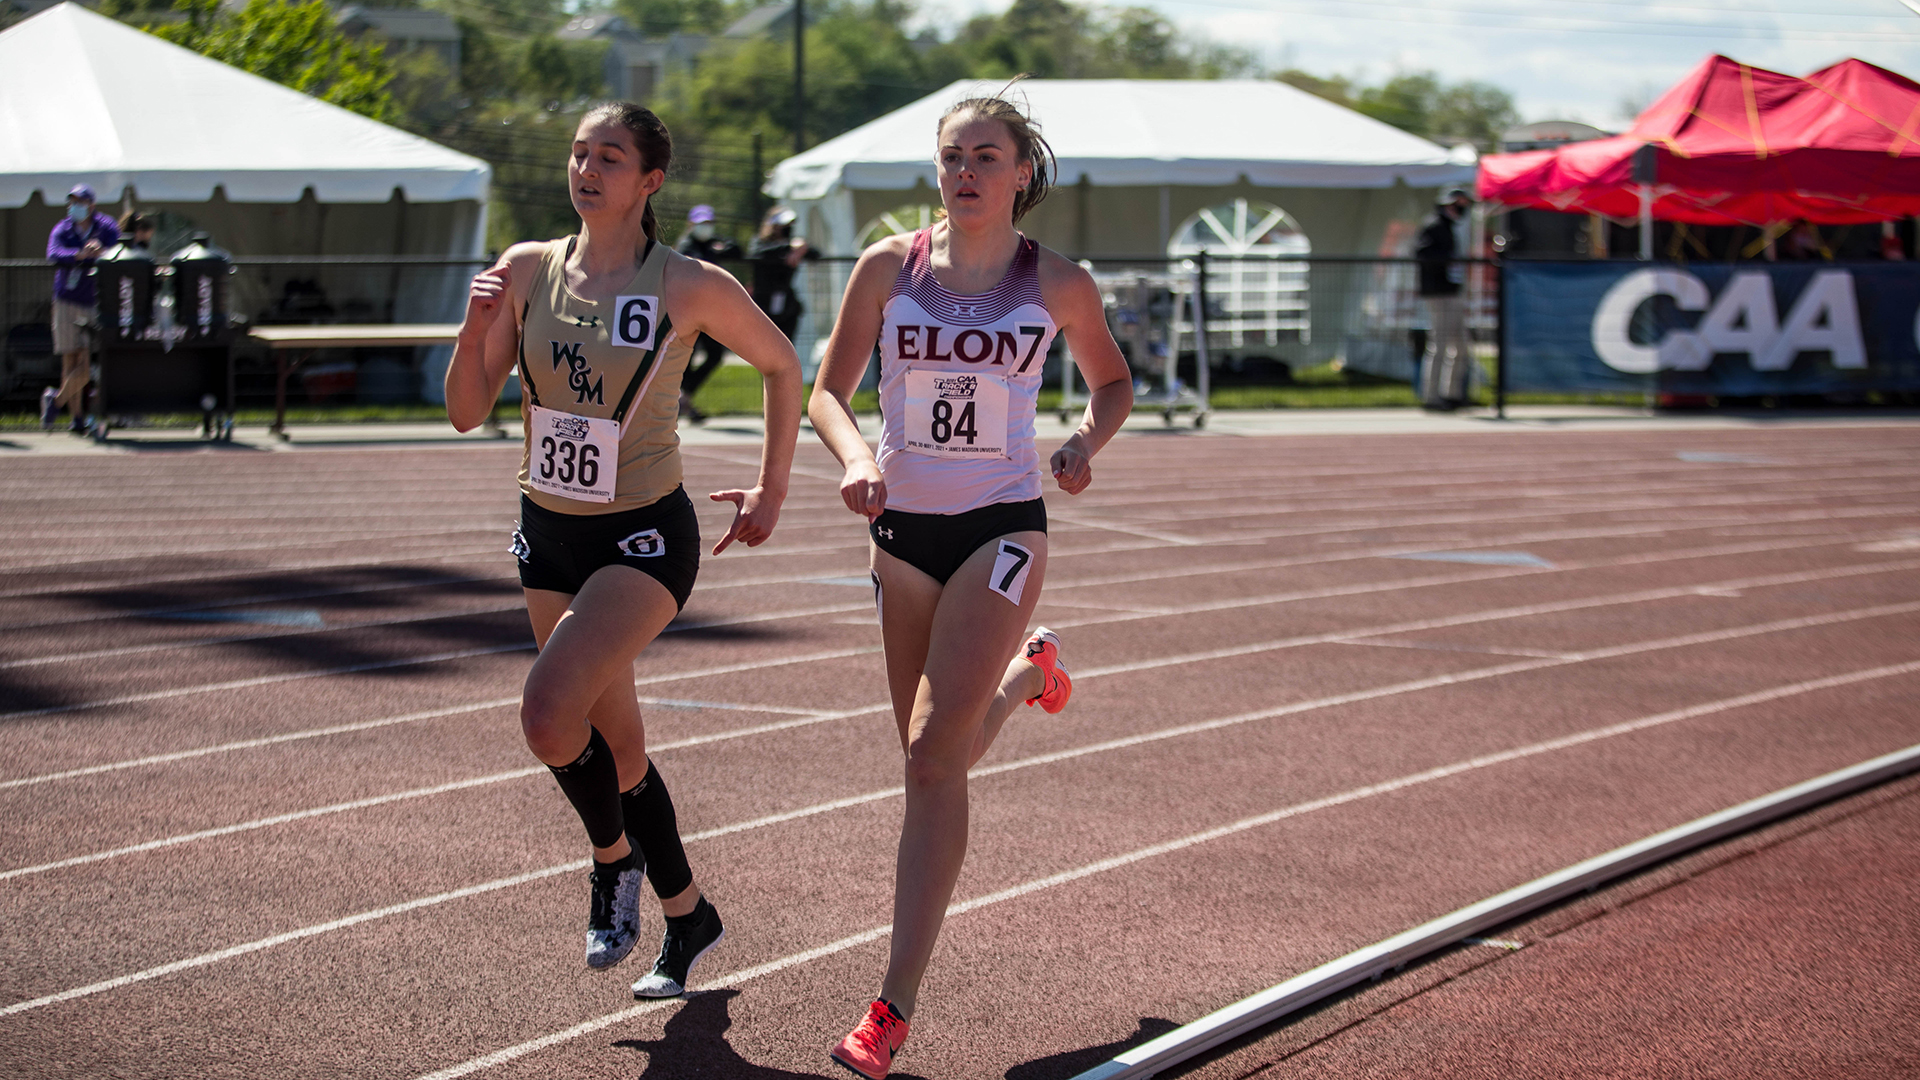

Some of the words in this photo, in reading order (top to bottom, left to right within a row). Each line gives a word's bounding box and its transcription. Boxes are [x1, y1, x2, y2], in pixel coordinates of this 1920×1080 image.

[619, 299, 651, 344] 6
[1591, 268, 1868, 374] CAA
[896, 325, 1017, 366] ELON
[1017, 326, 1046, 373] 7
[934, 378, 967, 389] TRACK
[939, 389, 971, 398] FIELD
[957, 375, 977, 383] CAA
[931, 400, 977, 445] 84
[540, 436, 600, 487] 336
[998, 544, 1029, 593] 7
